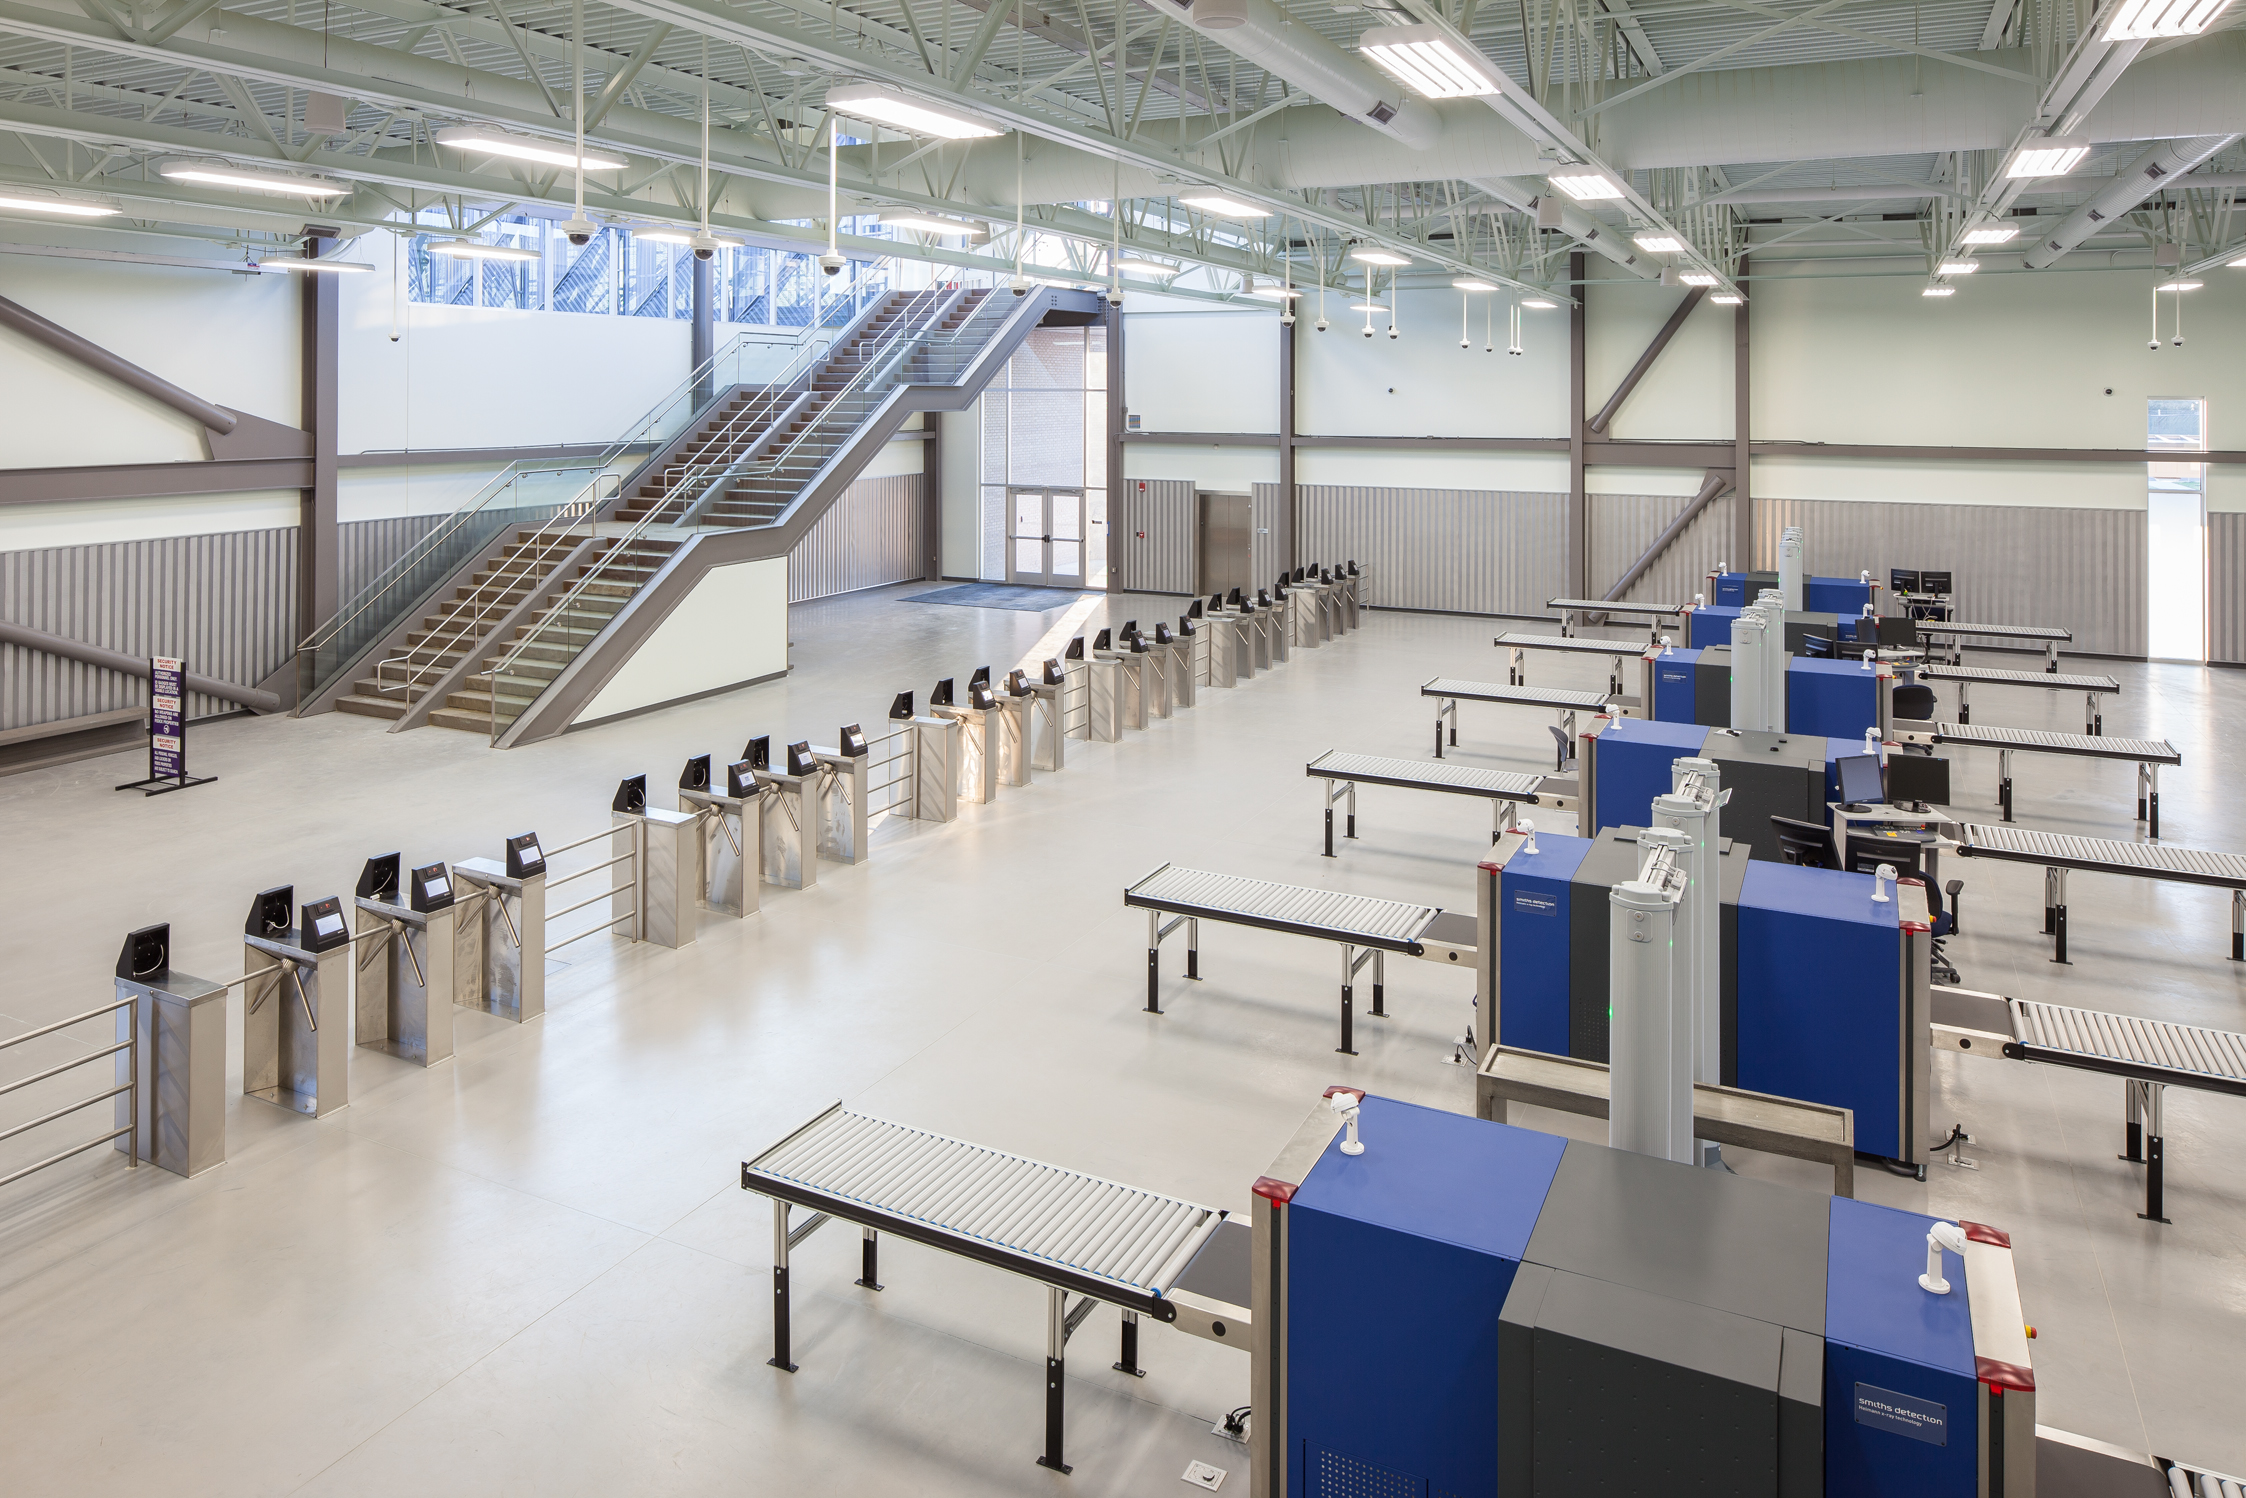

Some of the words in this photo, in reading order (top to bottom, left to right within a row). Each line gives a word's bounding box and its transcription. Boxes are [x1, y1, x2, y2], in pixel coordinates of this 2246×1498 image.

[1858, 1398, 1893, 1412] smiths
[1894, 1407, 1943, 1426] detection
[1858, 1405, 1881, 1415] Heimann
[1895, 1415, 1922, 1427] technology
